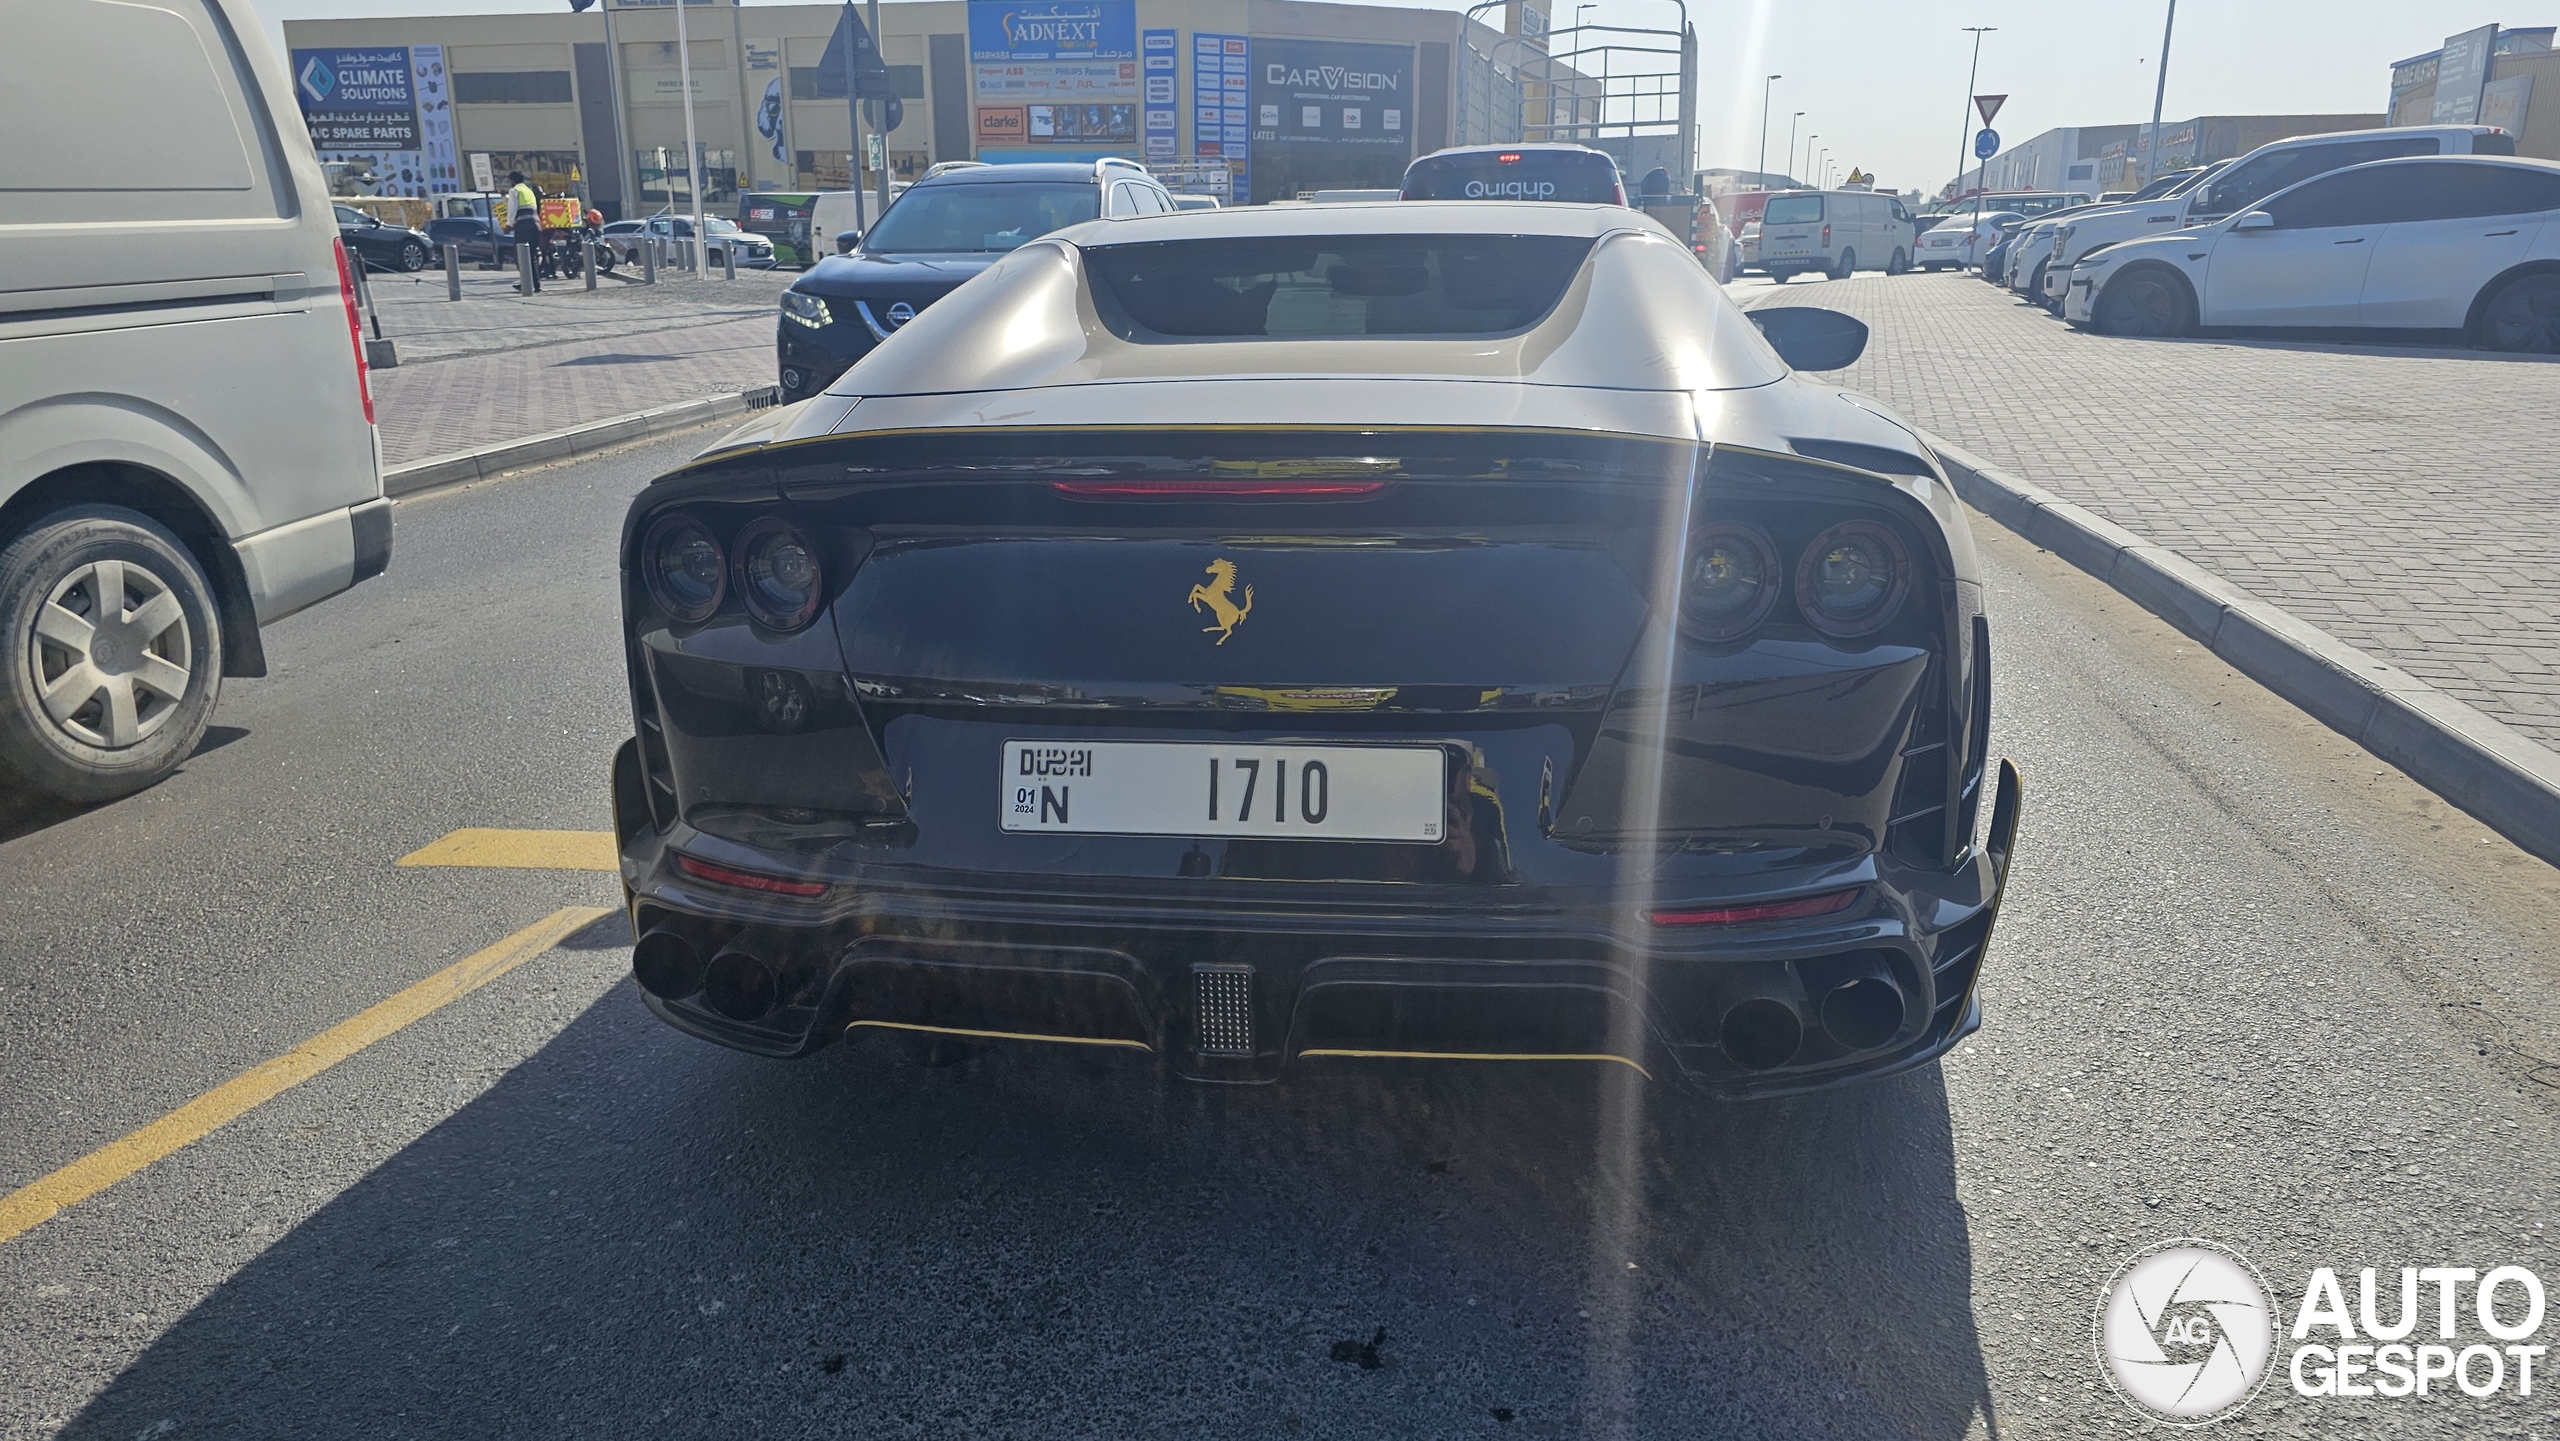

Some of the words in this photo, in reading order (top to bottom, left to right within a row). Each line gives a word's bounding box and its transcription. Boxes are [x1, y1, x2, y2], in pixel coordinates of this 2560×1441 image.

[974, 52, 1011, 60] MARHABA
[1005, 67, 1024, 76] ABB
[1055, 67, 1083, 76] PHILIPS
[1084, 66, 1117, 76] Panasonic
[339, 70, 405, 86] CLIMATE
[341, 88, 408, 100] SOLUTIONS
[984, 115, 1019, 128] clarke
[310, 128, 329, 138] A/C
[333, 128, 371, 138] SPARE
[374, 128, 412, 138] PARTS
[1253, 131, 1275, 141] LATES
[1465, 181, 1555, 200] Quiqup
[1020, 749, 1092, 776] DUBAI
[1016, 788, 1036, 804] 01
[1208, 758, 1329, 825] 1710
[1014, 804, 1034, 814] 2024
[1041, 785, 1069, 824] N
